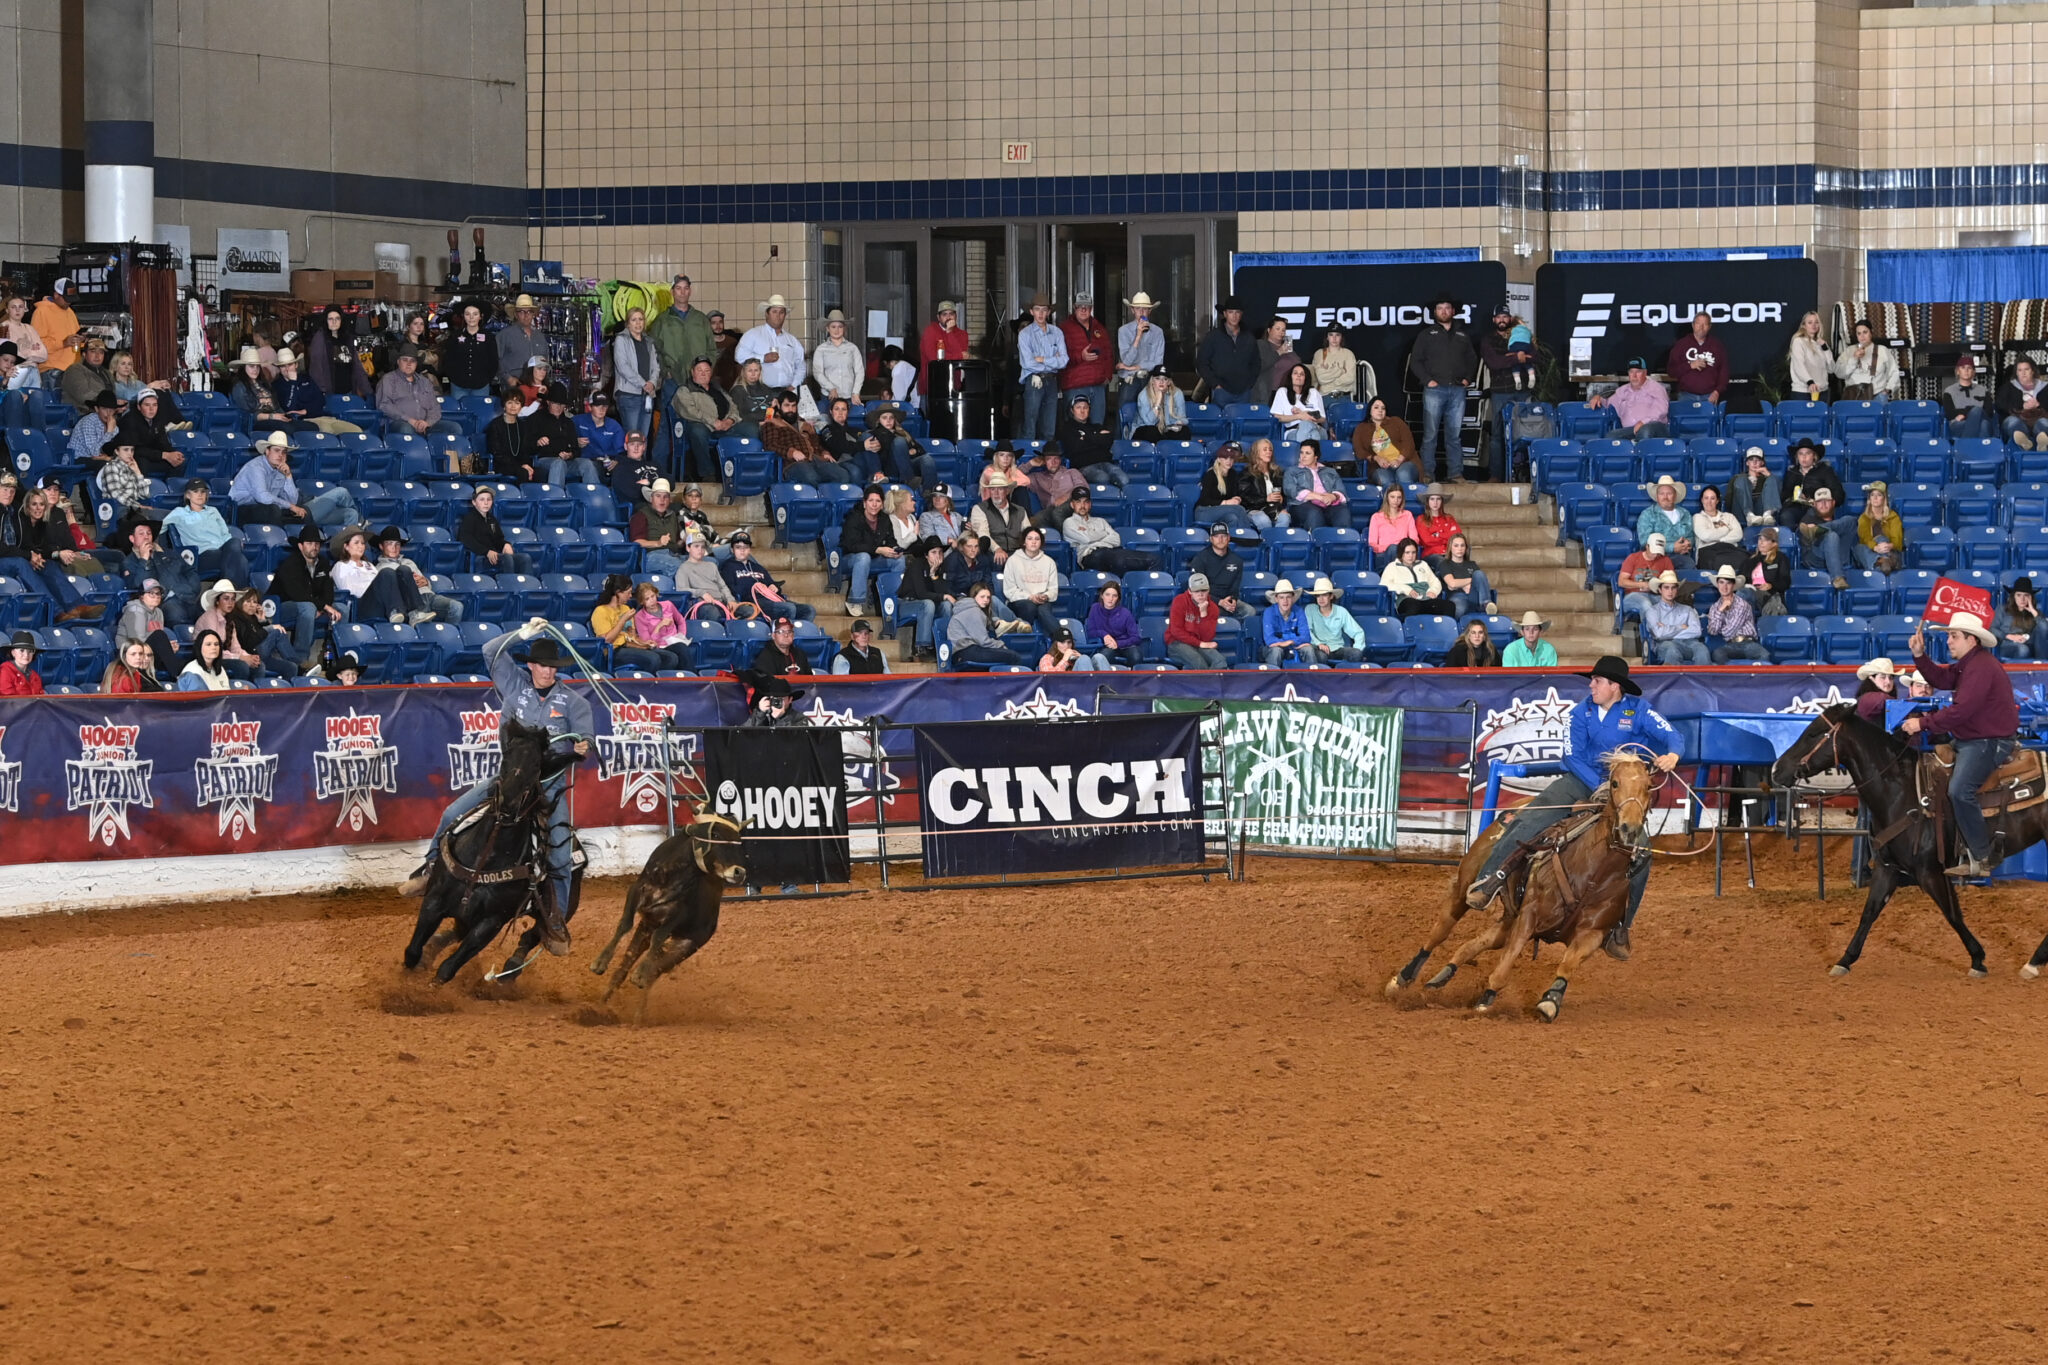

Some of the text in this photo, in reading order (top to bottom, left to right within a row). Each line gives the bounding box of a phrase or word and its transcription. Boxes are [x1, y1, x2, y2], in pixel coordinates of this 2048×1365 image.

[1007, 144, 1028, 161] EXIT
[240, 251, 282, 264] MARTIN
[326, 716, 380, 739] HOOEY
[461, 711, 502, 732] HOO
[1200, 709, 1281, 747] TLAW
[80, 726, 139, 747] HOOEY
[212, 723, 260, 744] HOOEY
[477, 734, 500, 744] JUNI
[1535, 730, 1558, 738] TH
[96, 751, 126, 761] JUNIOR
[221, 747, 250, 758] JUNIOR
[340, 741, 374, 751] JUNIOR
[1486, 743, 1563, 764] PATR
[449, 747, 502, 786] PATR
[598, 738, 695, 779] PATROT
[196, 756, 278, 805] PATRIOT
[315, 749, 397, 799] PATRIOT
[66, 763, 152, 810] PATRIOT
[928, 757, 1191, 825] CINCH
[744, 786, 837, 829] HOOEY
[1262, 822, 1344, 841] CHAMPIONS
[474, 869, 514, 884] ADDLES
